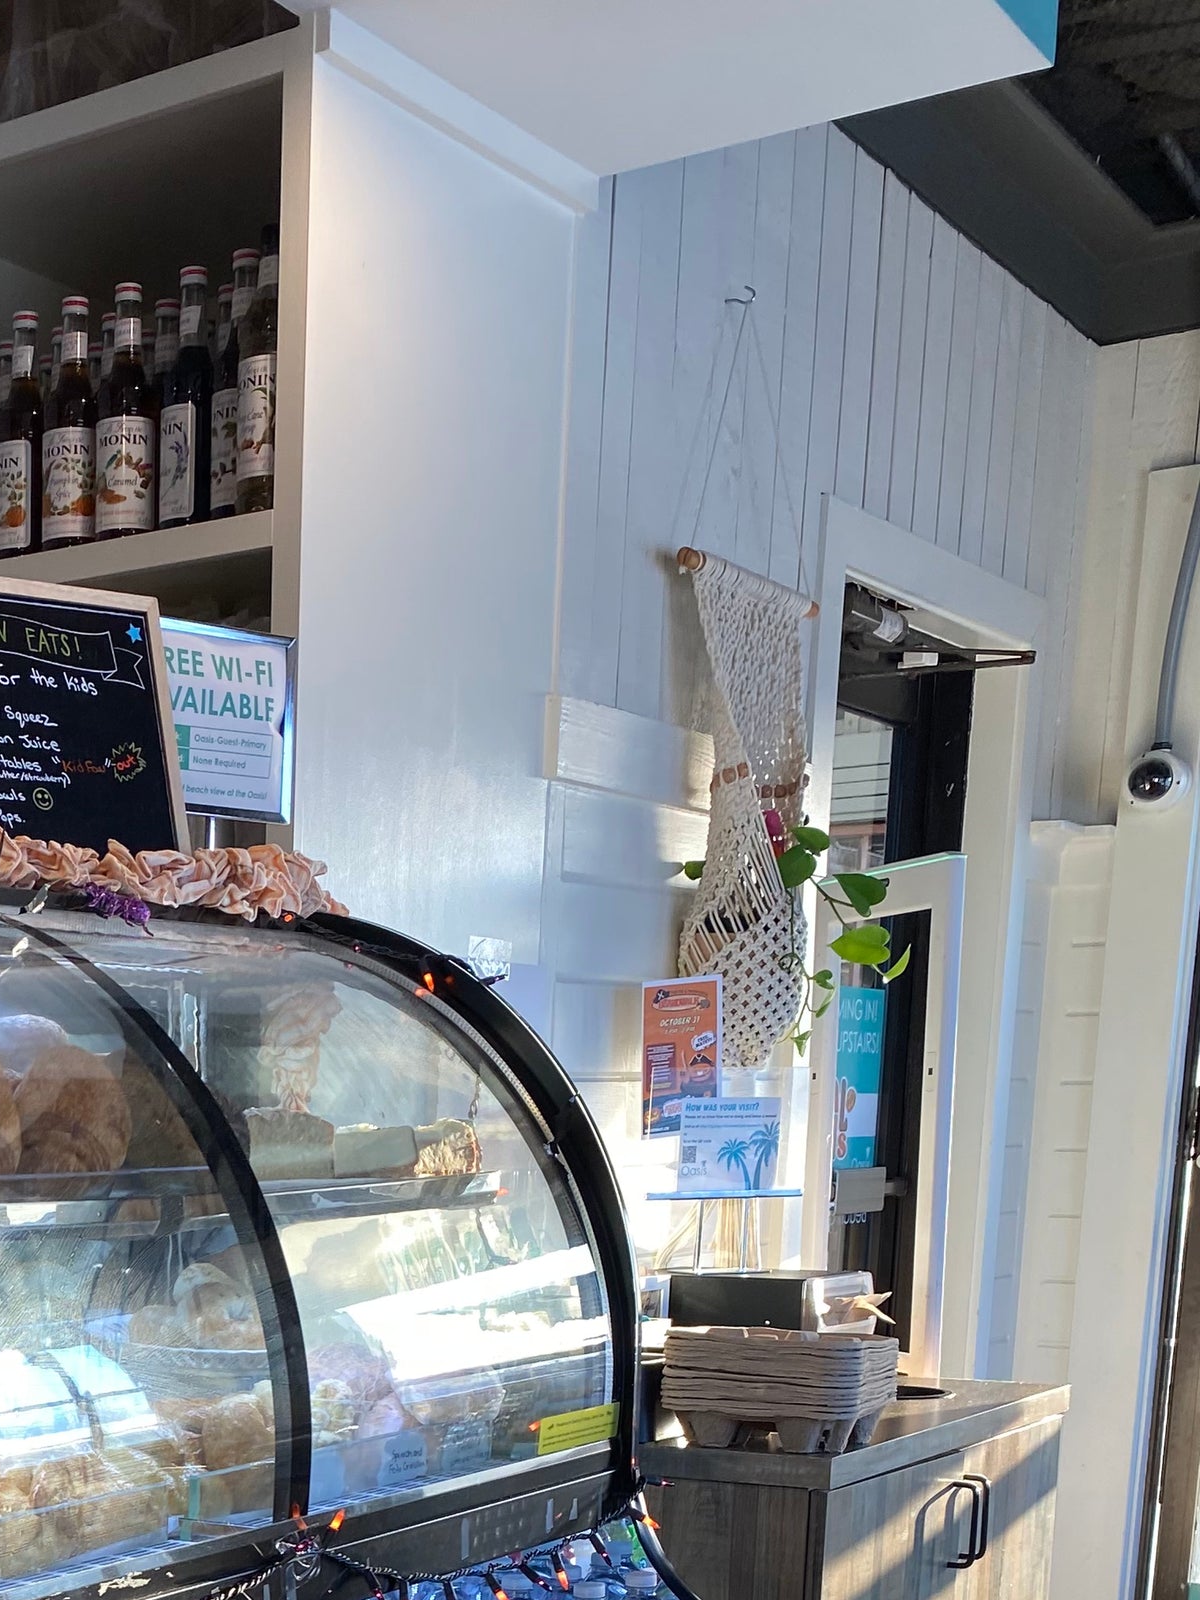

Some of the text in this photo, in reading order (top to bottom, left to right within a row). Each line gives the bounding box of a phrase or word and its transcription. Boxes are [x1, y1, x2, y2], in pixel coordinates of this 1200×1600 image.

[99, 434, 148, 447] MONIN
[107, 473, 139, 488] Caramel
[26, 628, 82, 660] EATS!
[165, 646, 273, 688] REE WI-FI
[30, 668, 58, 688] the
[170, 686, 274, 722] VAILABLE
[18, 733, 61, 752] Juice
[193, 756, 212, 765] None
[215, 758, 246, 769] Required
[186, 784, 208, 793] beach
[227, 789, 234, 797] at
[236, 789, 246, 797] the
[681, 1166, 707, 1176] Oasis
